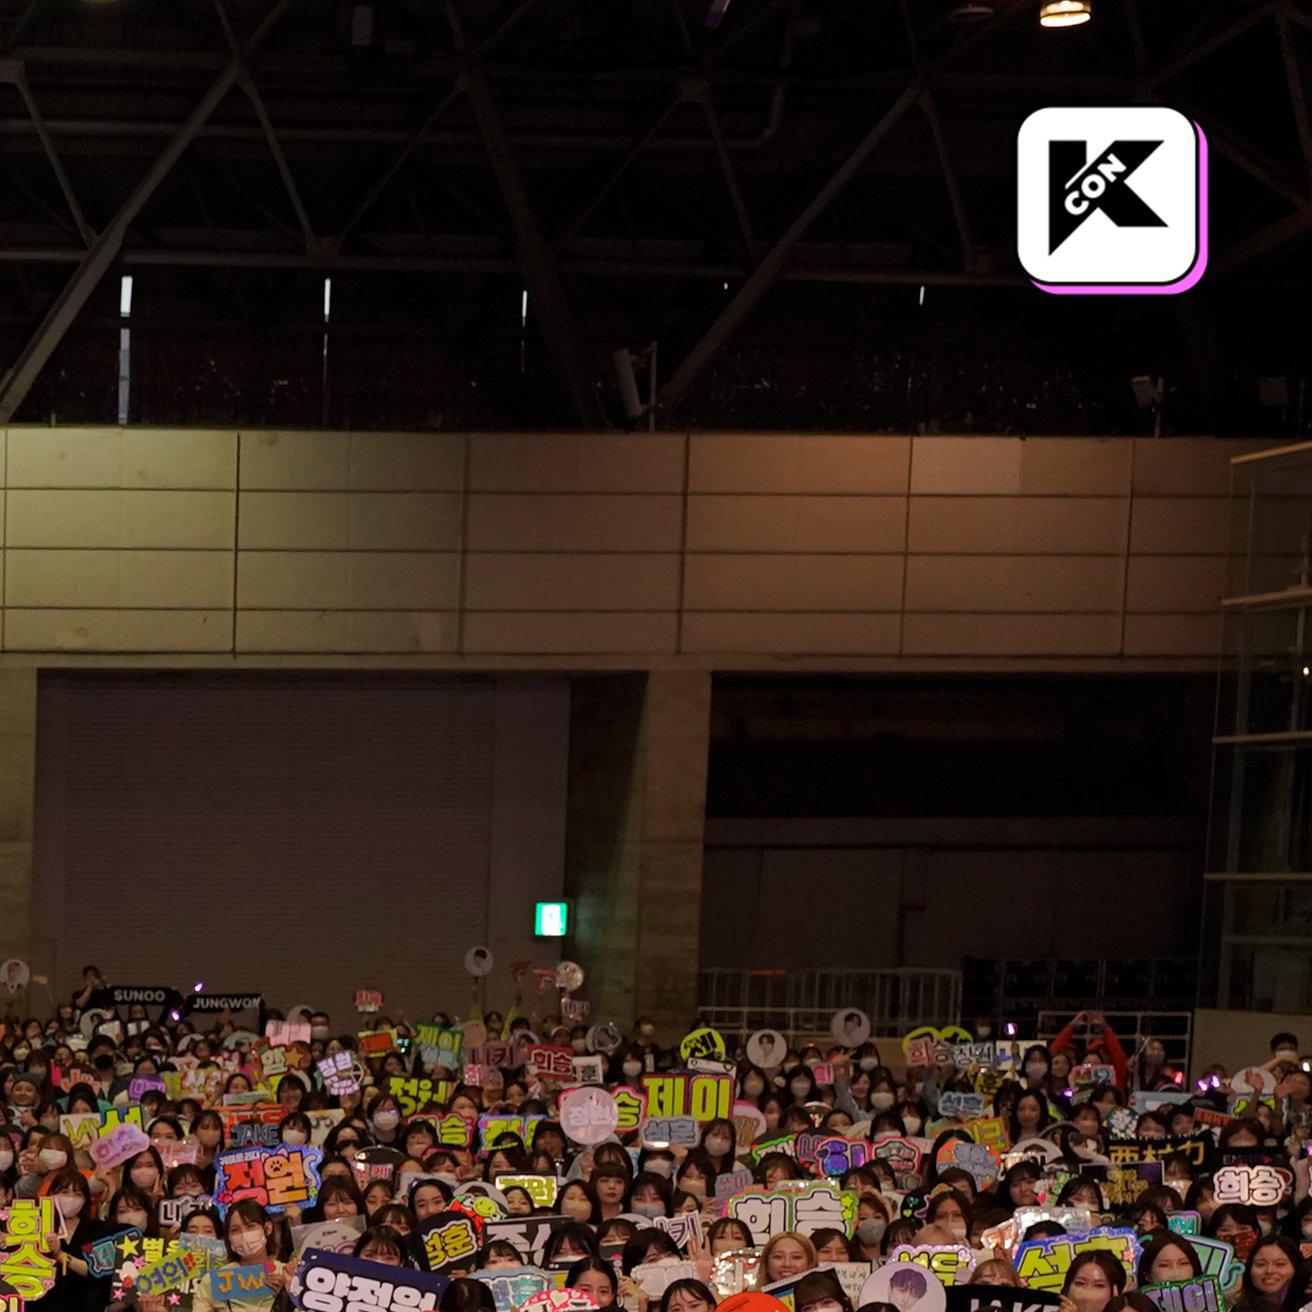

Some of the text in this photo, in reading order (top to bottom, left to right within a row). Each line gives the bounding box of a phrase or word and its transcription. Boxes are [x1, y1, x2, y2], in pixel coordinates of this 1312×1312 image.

[113, 989, 167, 1002] SUNOO
[645, 1079, 733, 1121] 제이
[232, 1123, 277, 1147] JAKE
[1217, 1169, 1283, 1206] 희승
[0, 1197, 57, 1300] 희승
